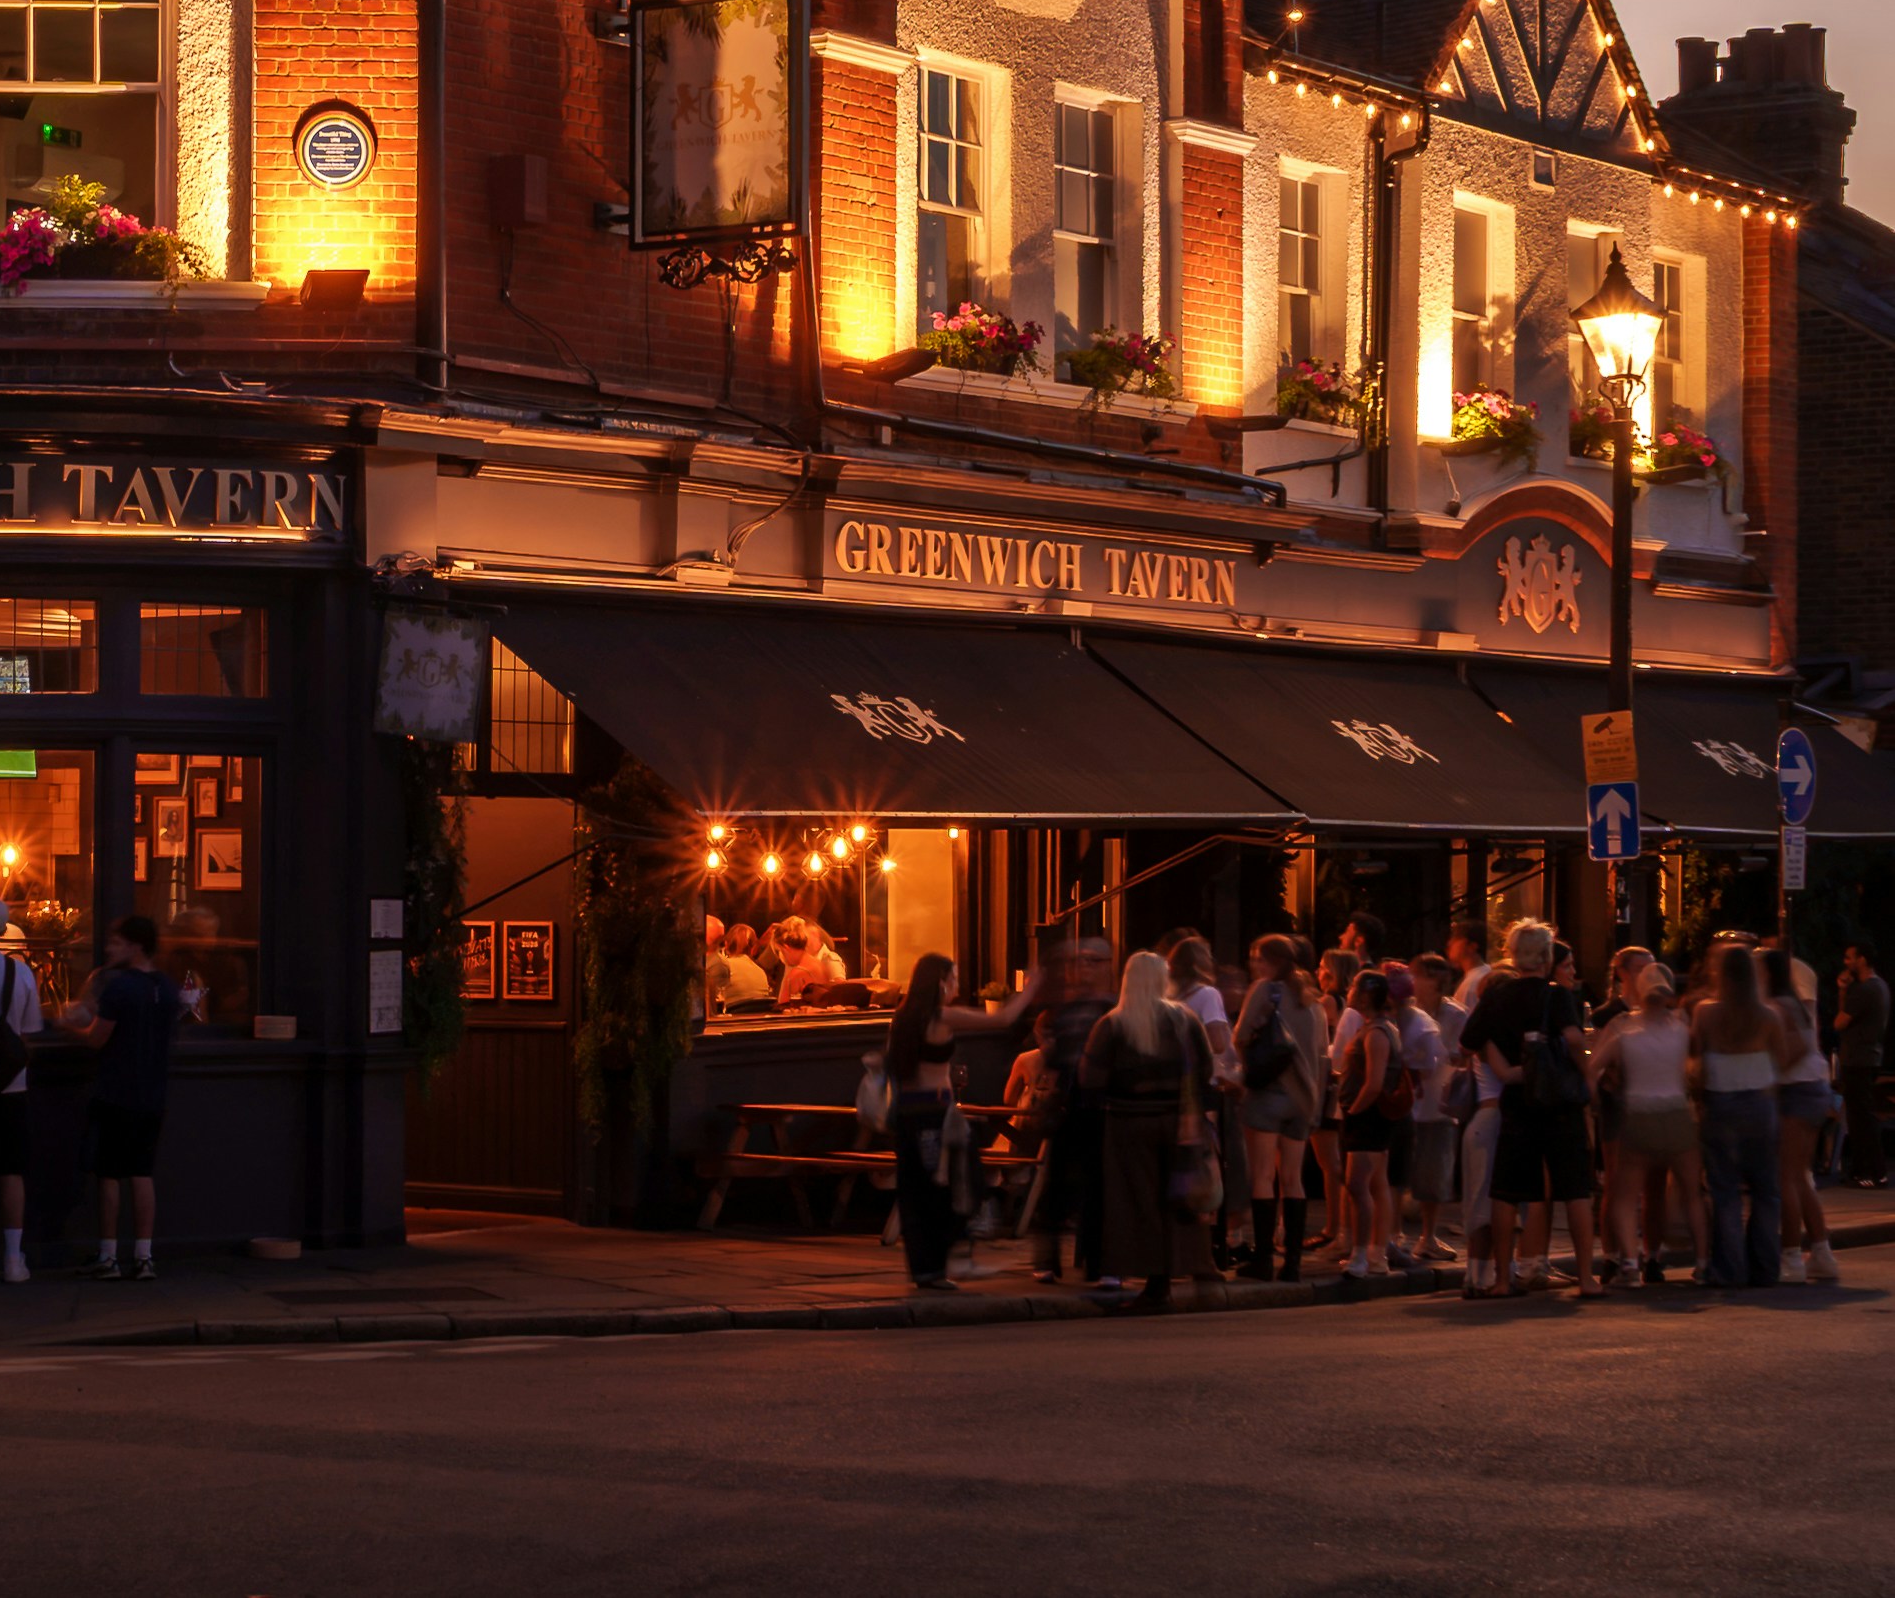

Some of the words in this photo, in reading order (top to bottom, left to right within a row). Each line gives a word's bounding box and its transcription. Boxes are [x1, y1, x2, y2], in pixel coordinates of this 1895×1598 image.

[62, 462, 348, 532] TAVERN
[836, 521, 1082, 591] GREENWICH
[1106, 549, 1236, 605] TAVERN
